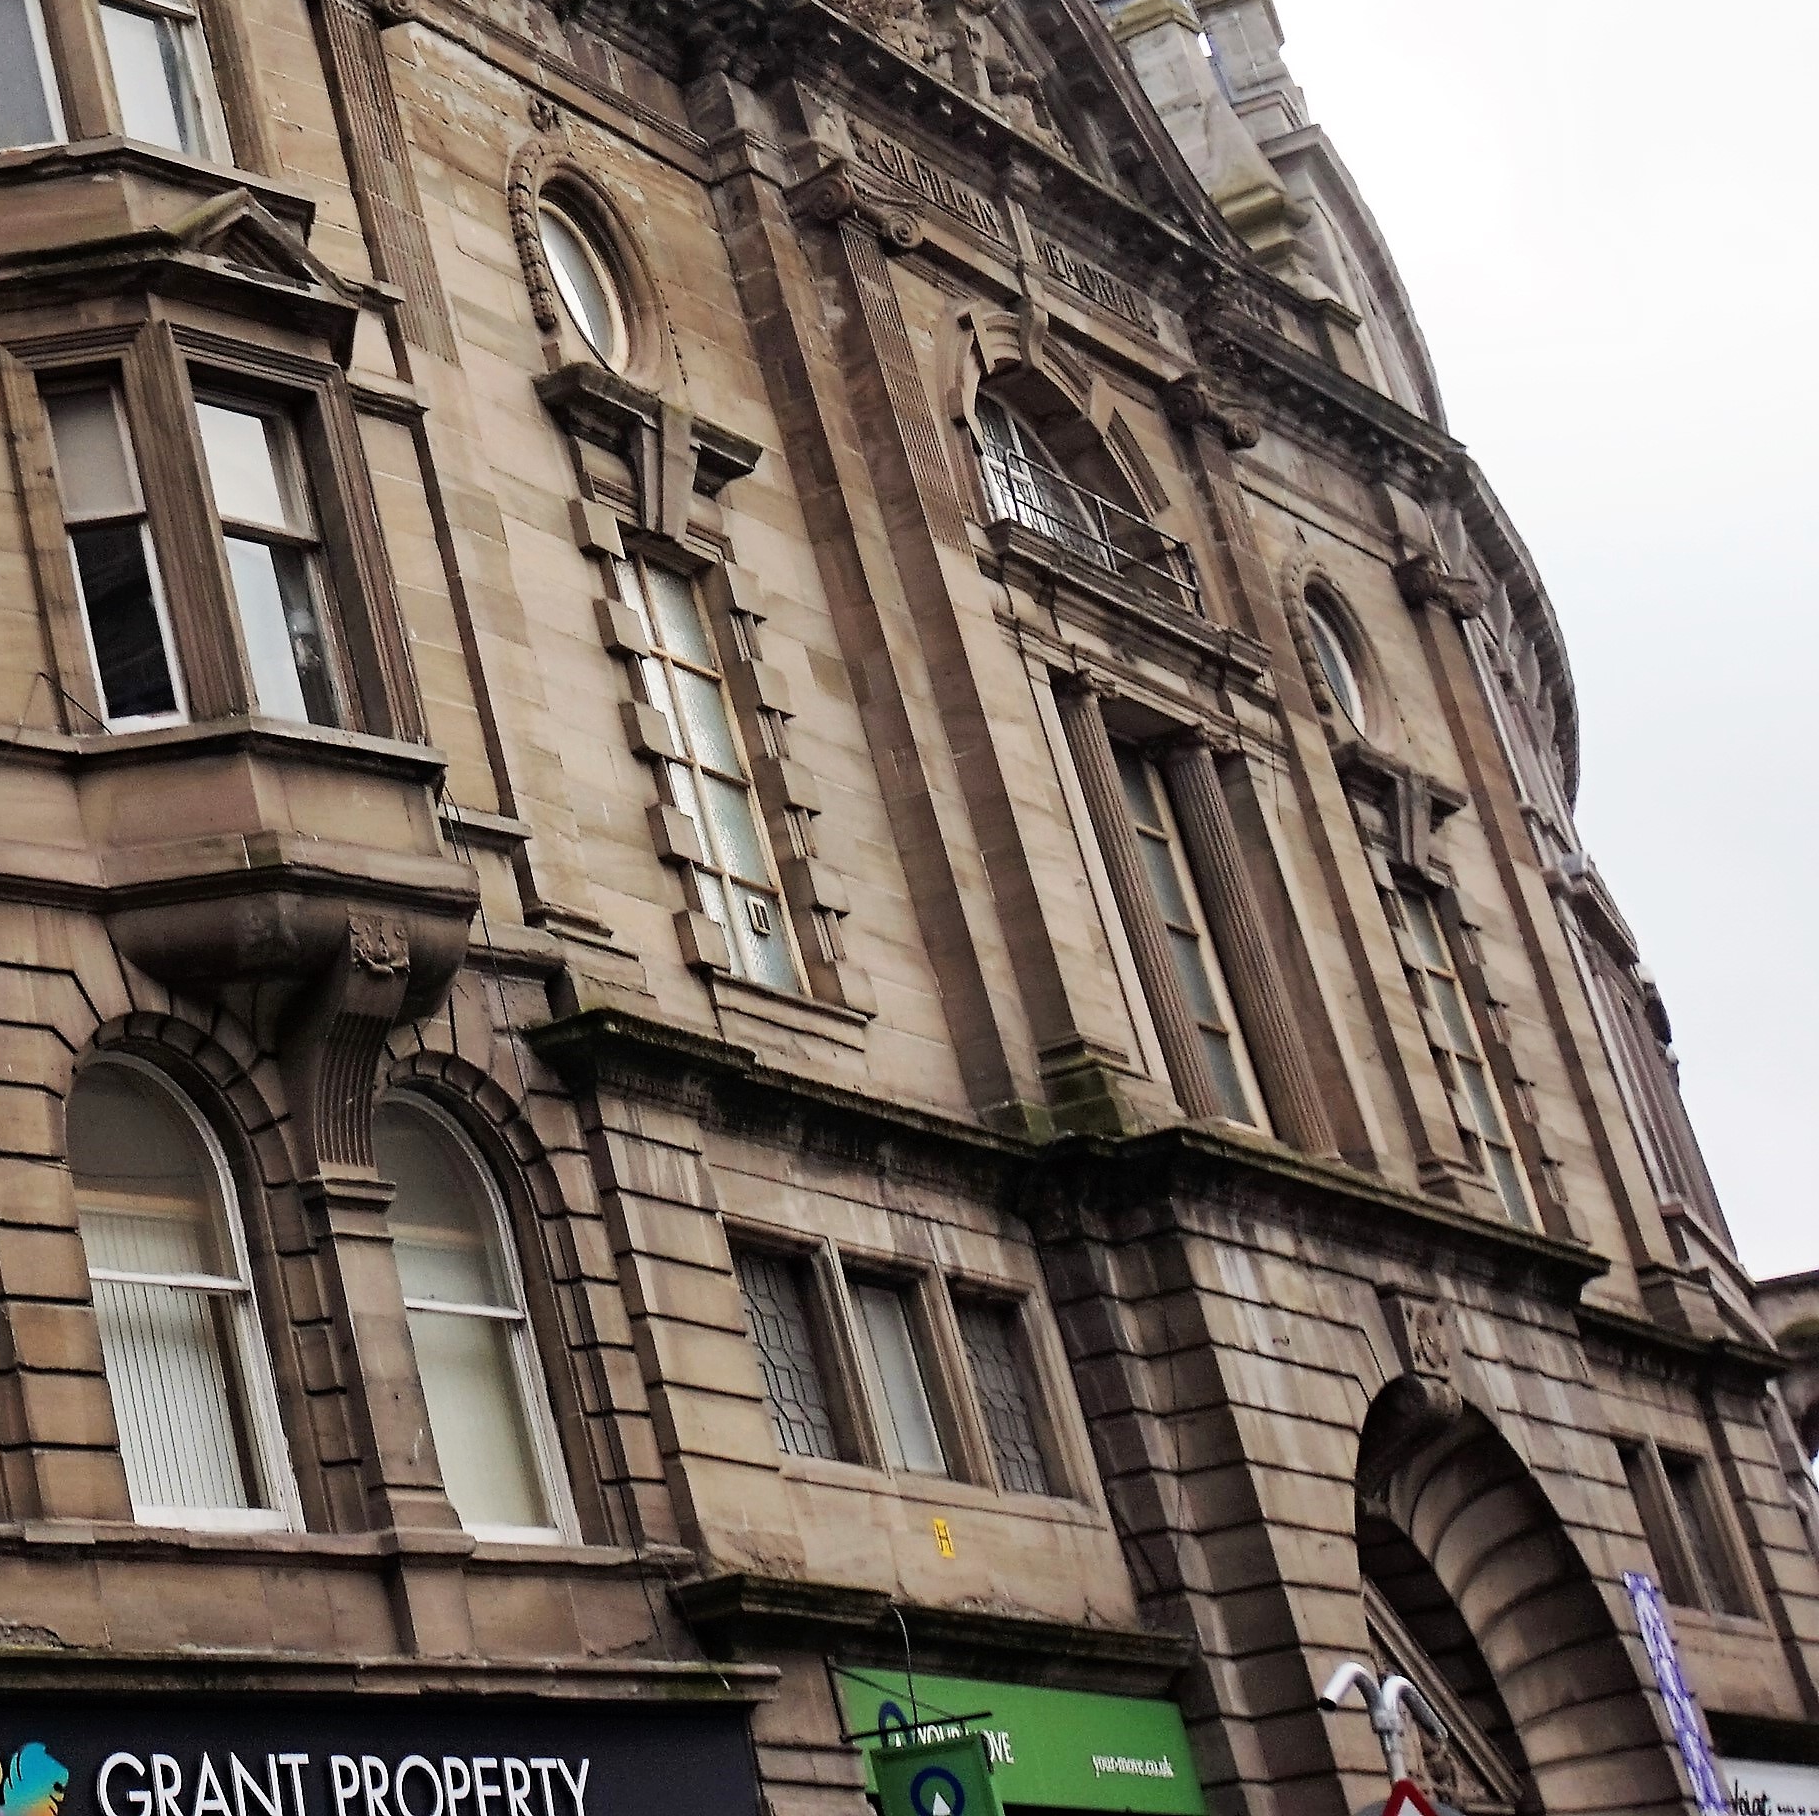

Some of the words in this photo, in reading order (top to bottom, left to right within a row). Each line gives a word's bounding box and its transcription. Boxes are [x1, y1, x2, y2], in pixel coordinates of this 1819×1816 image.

[936, 1524, 952, 1552] H
[97, 1751, 310, 1816] GRANT
[329, 1754, 591, 1816] PROPERTY
